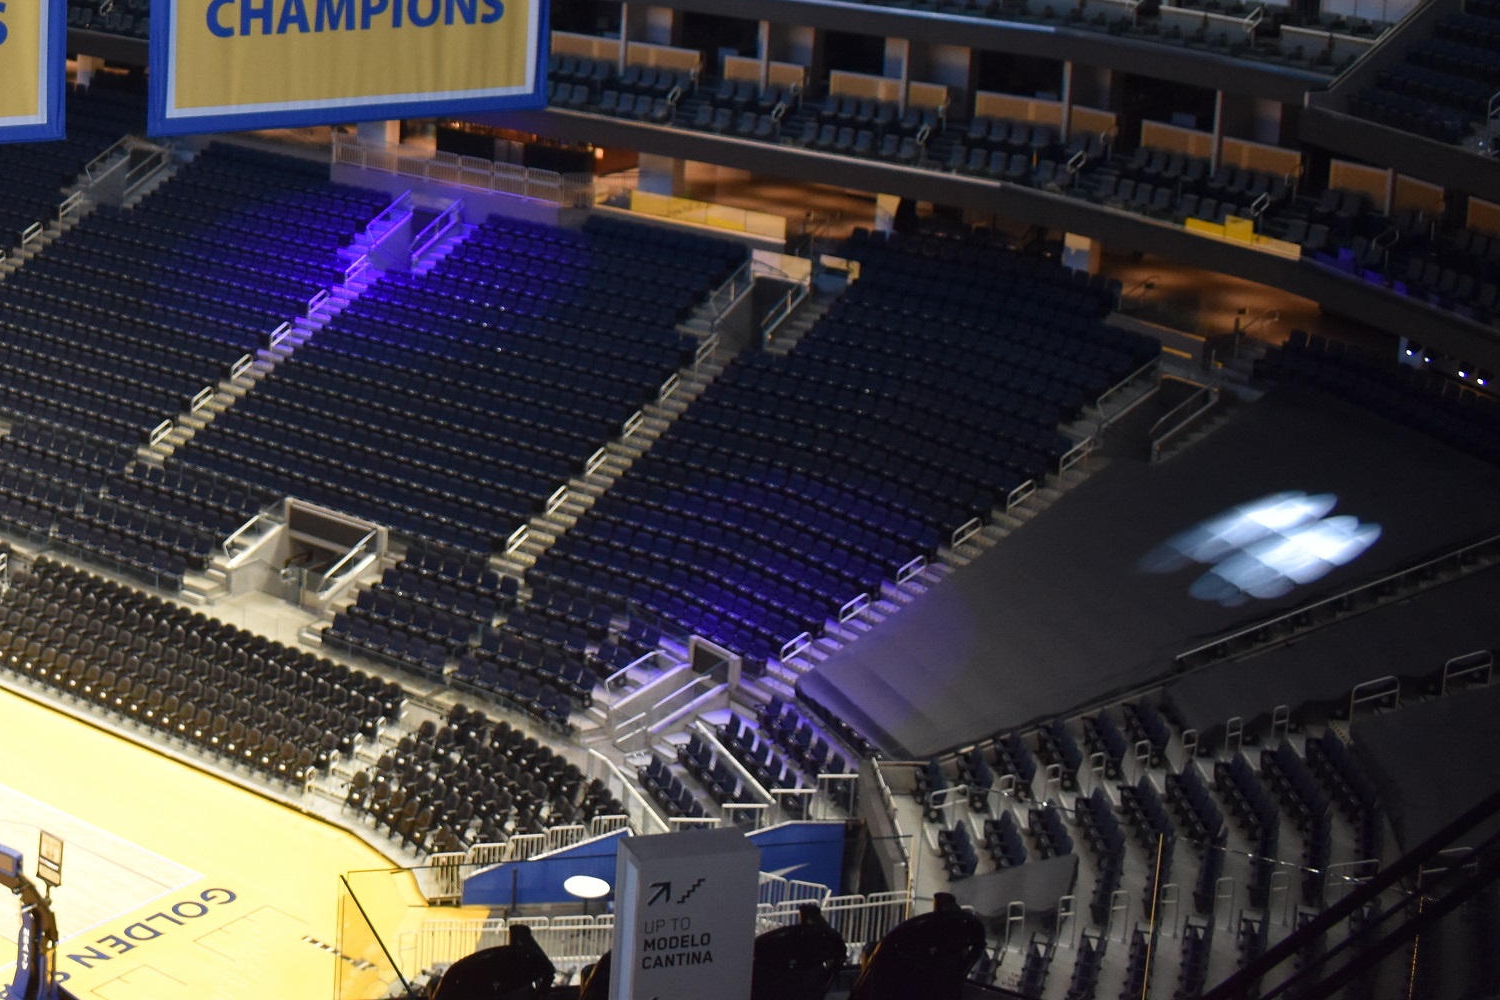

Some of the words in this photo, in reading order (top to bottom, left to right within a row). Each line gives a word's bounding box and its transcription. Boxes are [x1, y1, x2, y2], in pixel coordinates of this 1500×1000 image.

[66, 887, 237, 969] GOLDEN
[644, 919, 666, 935] UP
[671, 916, 691, 931] TO
[643, 932, 712, 952] MODELO
[641, 950, 713, 970] CANTINA
